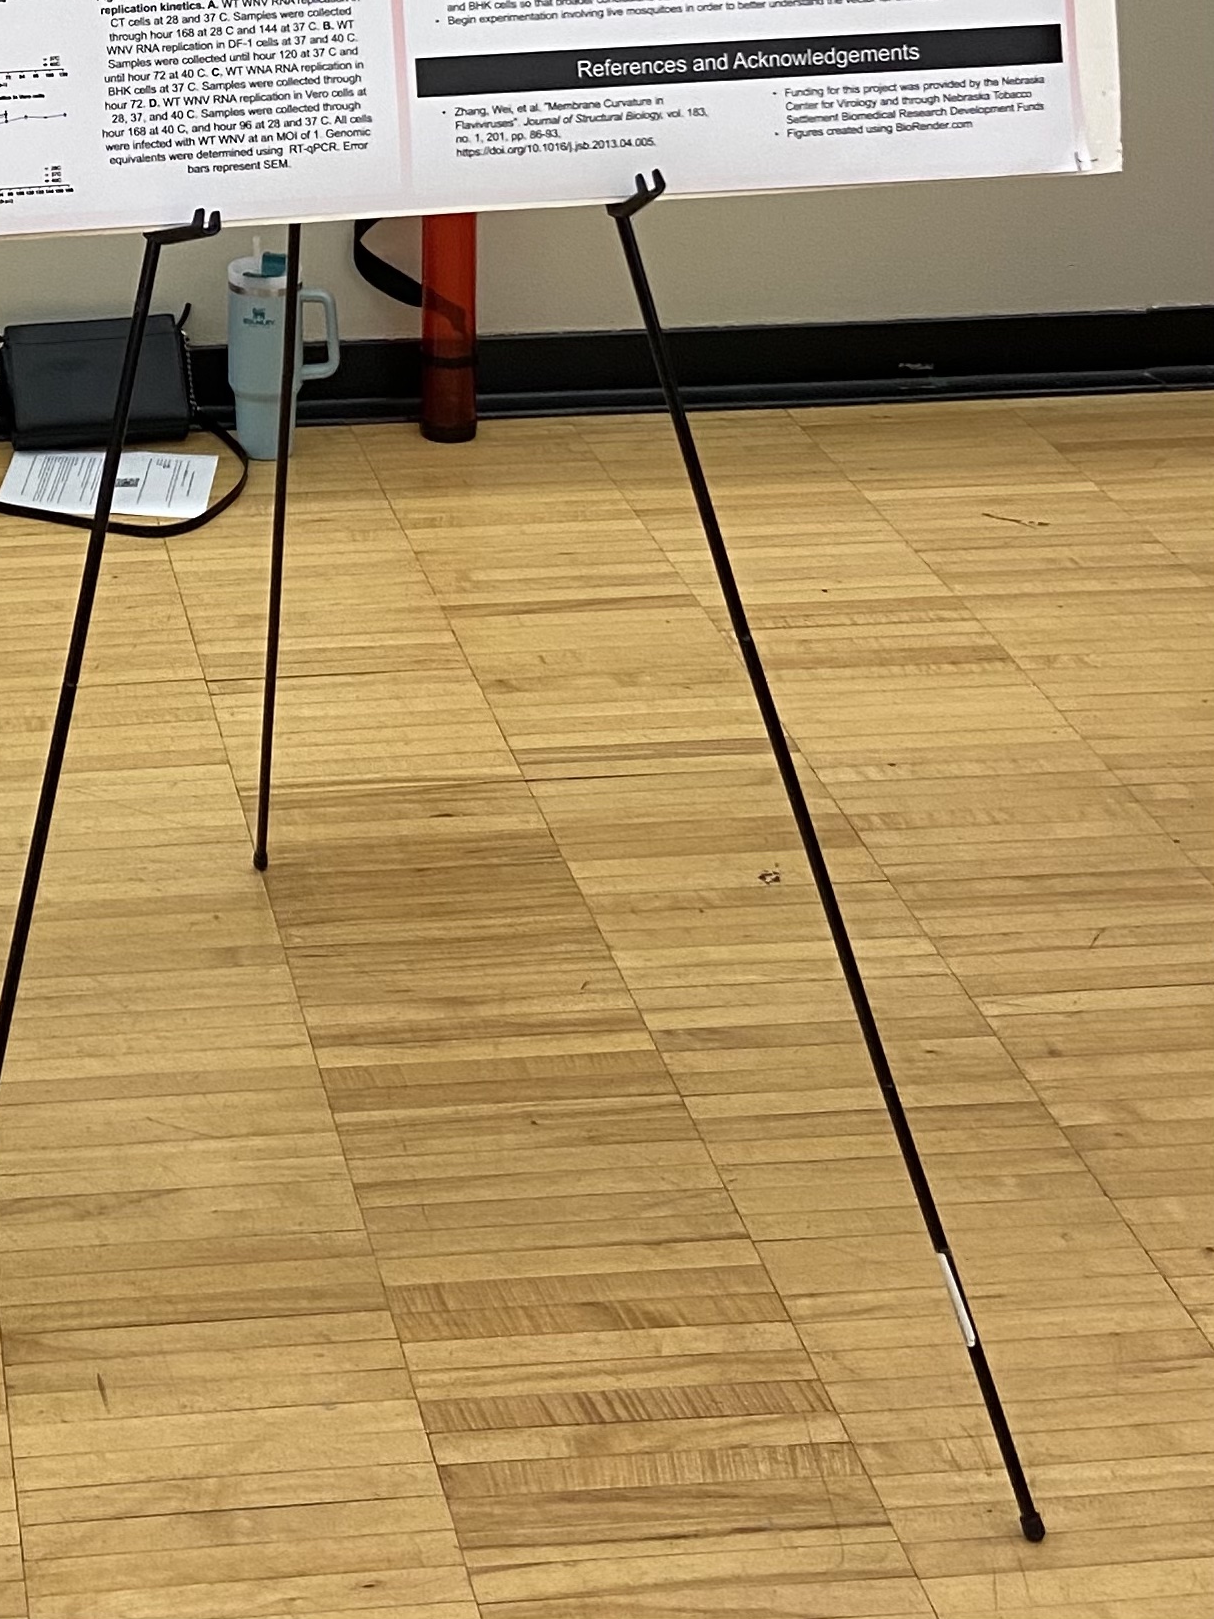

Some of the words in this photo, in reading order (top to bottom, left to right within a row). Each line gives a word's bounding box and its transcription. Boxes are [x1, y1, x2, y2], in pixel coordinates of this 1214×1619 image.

[577, 59, 687, 77] References
[692, 53, 728, 71] and
[732, 45, 920, 68] Acknowledgements
[187, 165, 210, 173] bars
[212, 161, 260, 173] represent
